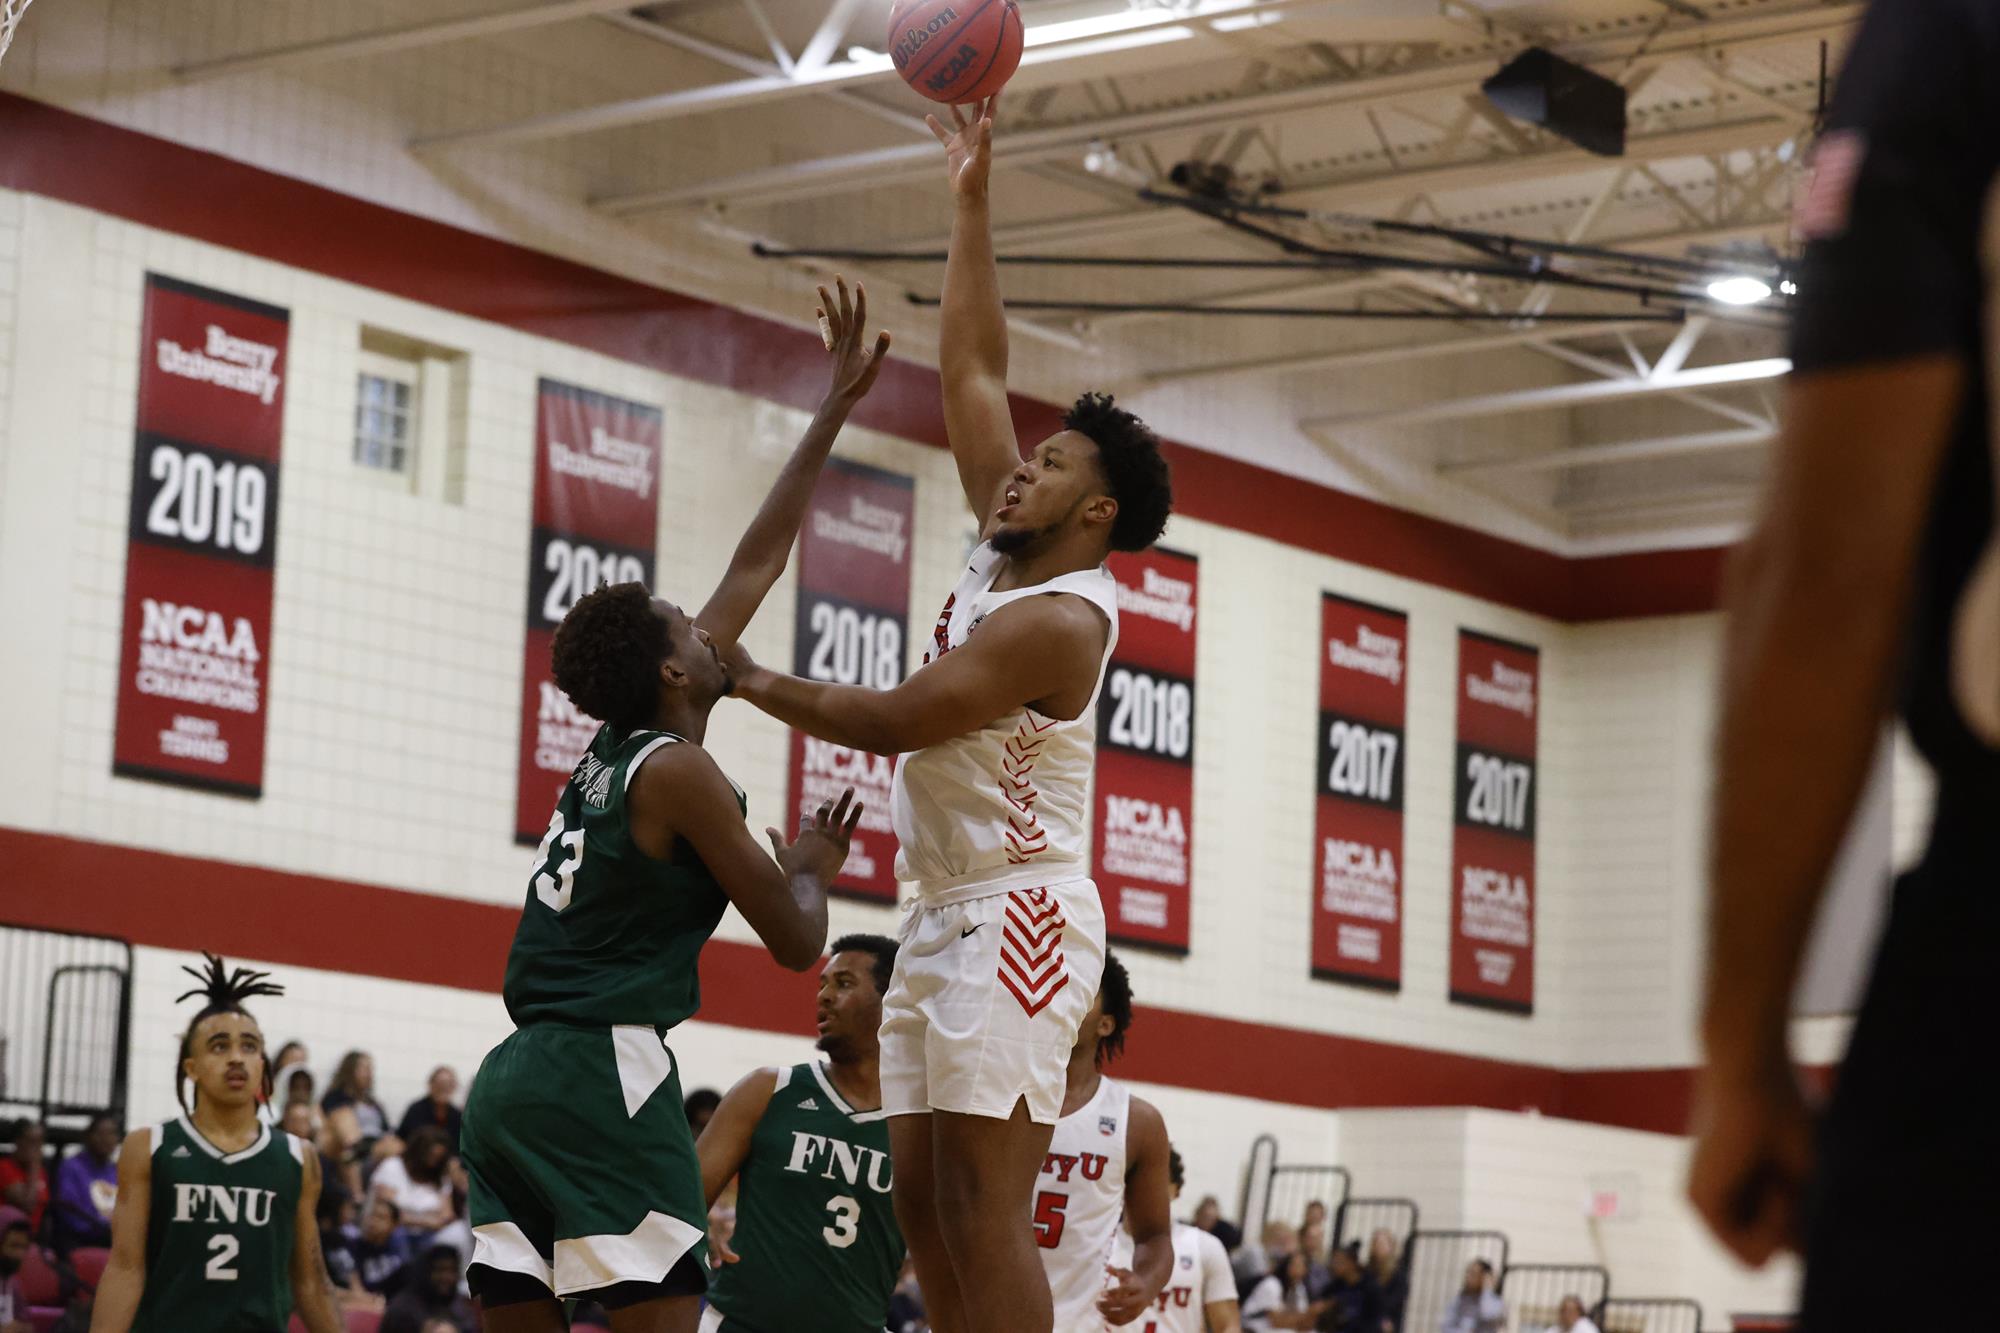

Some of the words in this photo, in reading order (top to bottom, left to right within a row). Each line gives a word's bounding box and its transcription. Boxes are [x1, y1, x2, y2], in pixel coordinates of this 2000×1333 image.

[147, 446, 266, 554] 2019
[141, 598, 259, 662] NCAA
[808, 602, 900, 691] 2018
[1109, 669, 1191, 758] 2018
[1328, 721, 1397, 801] 2017
[1104, 794, 1187, 845] NCAA
[1467, 752, 1531, 830] 2017
[1324, 837, 1396, 884] NCAA
[1463, 866, 1529, 912] NCAA
[784, 1131, 893, 1193] FNU
[173, 1183, 277, 1227] FNU
[823, 1195, 861, 1248] 3
[1033, 1191, 1068, 1249] 5
[206, 1234, 239, 1280] 2
[1157, 1286, 1192, 1313] YU
